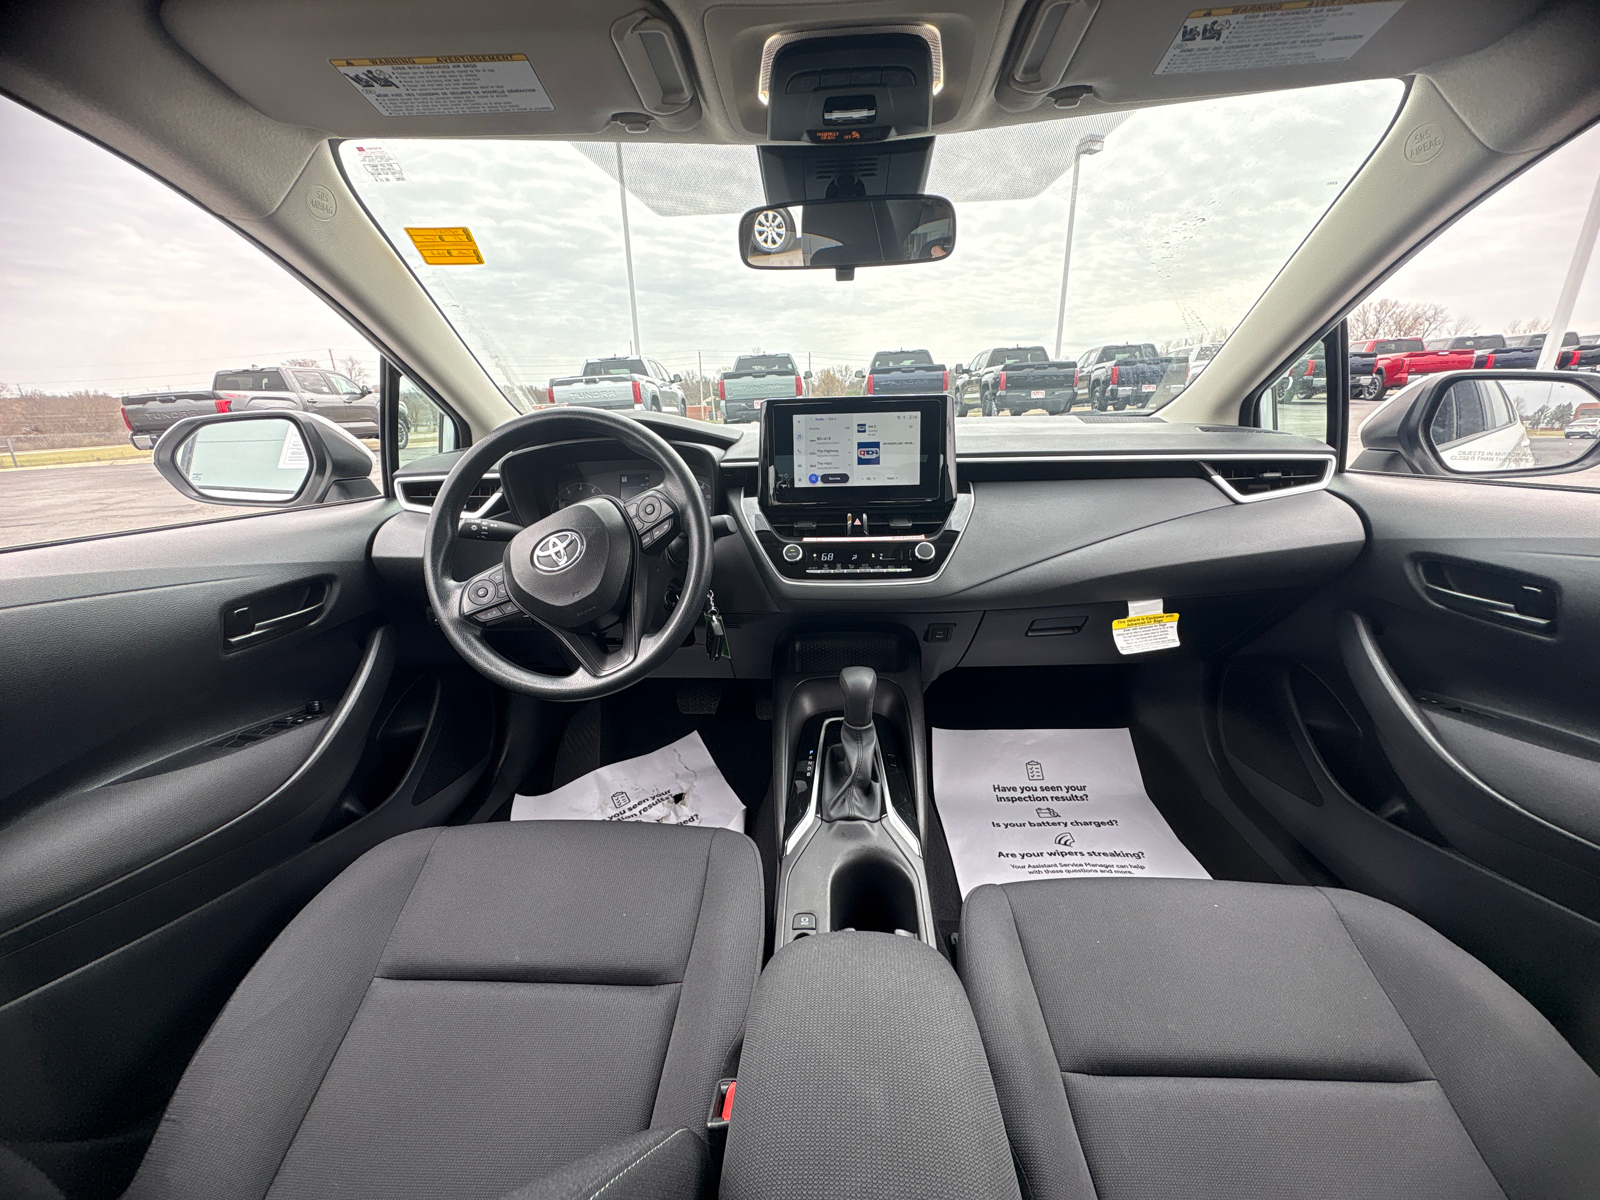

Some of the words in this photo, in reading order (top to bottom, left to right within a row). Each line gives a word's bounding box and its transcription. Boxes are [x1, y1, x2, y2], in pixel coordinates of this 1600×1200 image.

[368, 58, 416, 66] WARNING
[436, 54, 514, 64] AVERTISSEMENT
[1414, 130, 1430, 144] SRS
[1410, 136, 1441, 158] AIRBAG
[317, 190, 328, 202] SRS
[310, 199, 332, 214] AIRBAG
[570, 390, 616, 400] TUNDRA
[144, 410, 198, 420] TUNDRA
[821, 553, 834, 561] 68
[992, 784, 1017, 792] Have
[1064, 785, 1086, 793] your
[996, 795, 1049, 803] inspection
[608, 809, 626, 820] you
[628, 798, 649, 812] seen
[650, 789, 671, 800] your
[1070, 819, 1118, 828] charged?
[1046, 850, 1085, 858] wipers
[1087, 851, 1145, 859] streaking?
